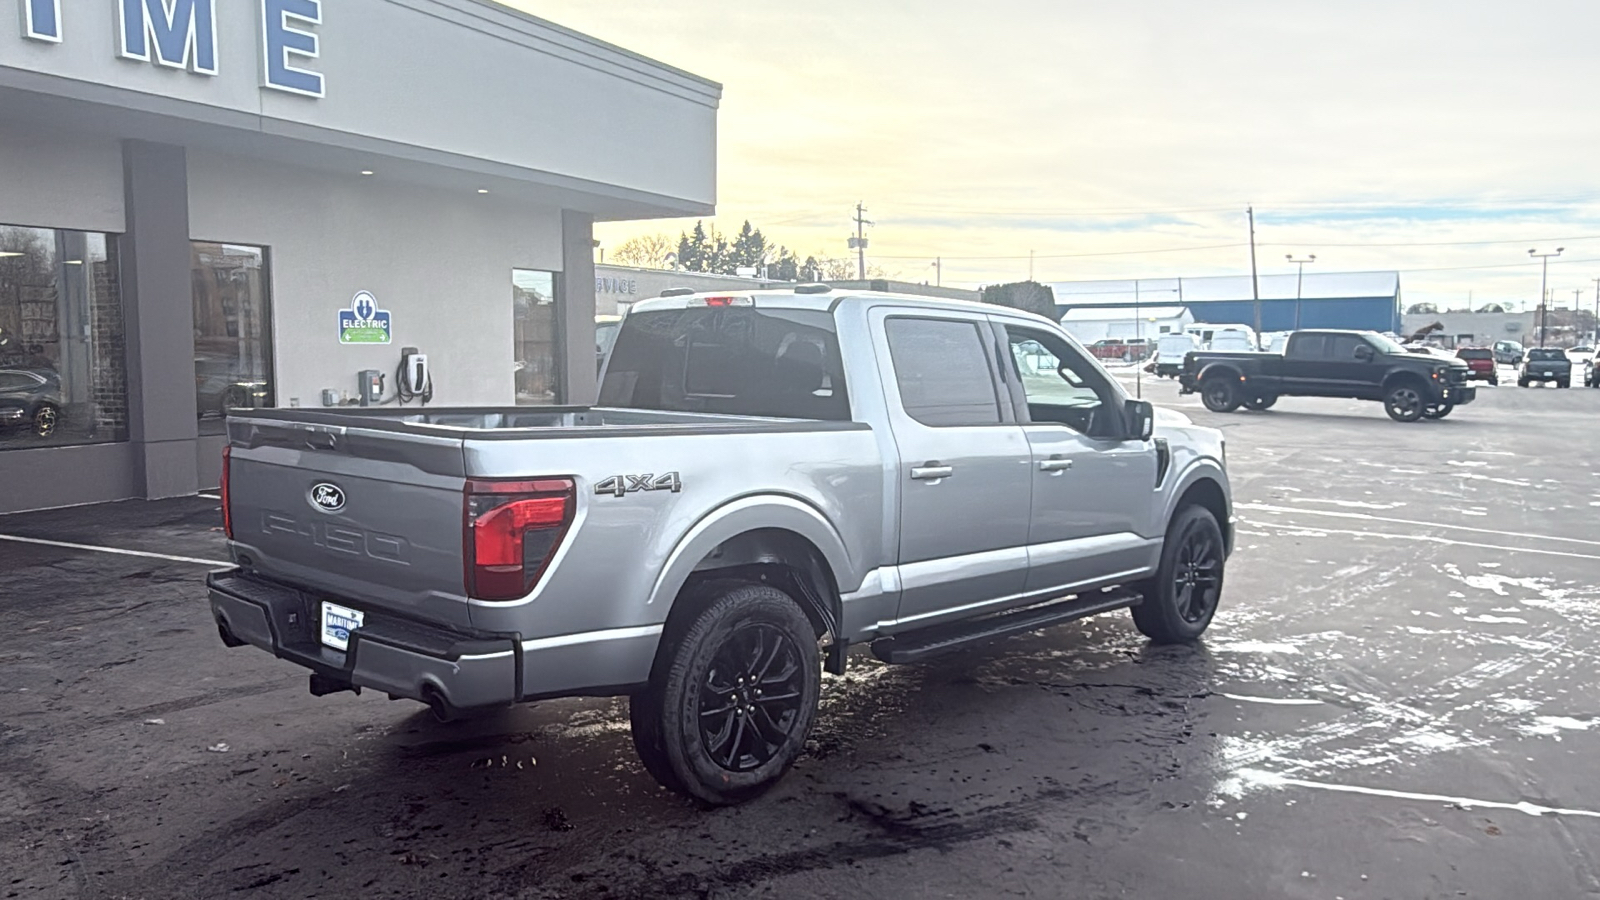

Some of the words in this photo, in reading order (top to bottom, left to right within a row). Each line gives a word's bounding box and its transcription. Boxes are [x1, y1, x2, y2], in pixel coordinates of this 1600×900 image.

[342, 319, 388, 329] ELECTRIC
[316, 485, 339, 506] Ford
[261, 509, 411, 566] F-150
